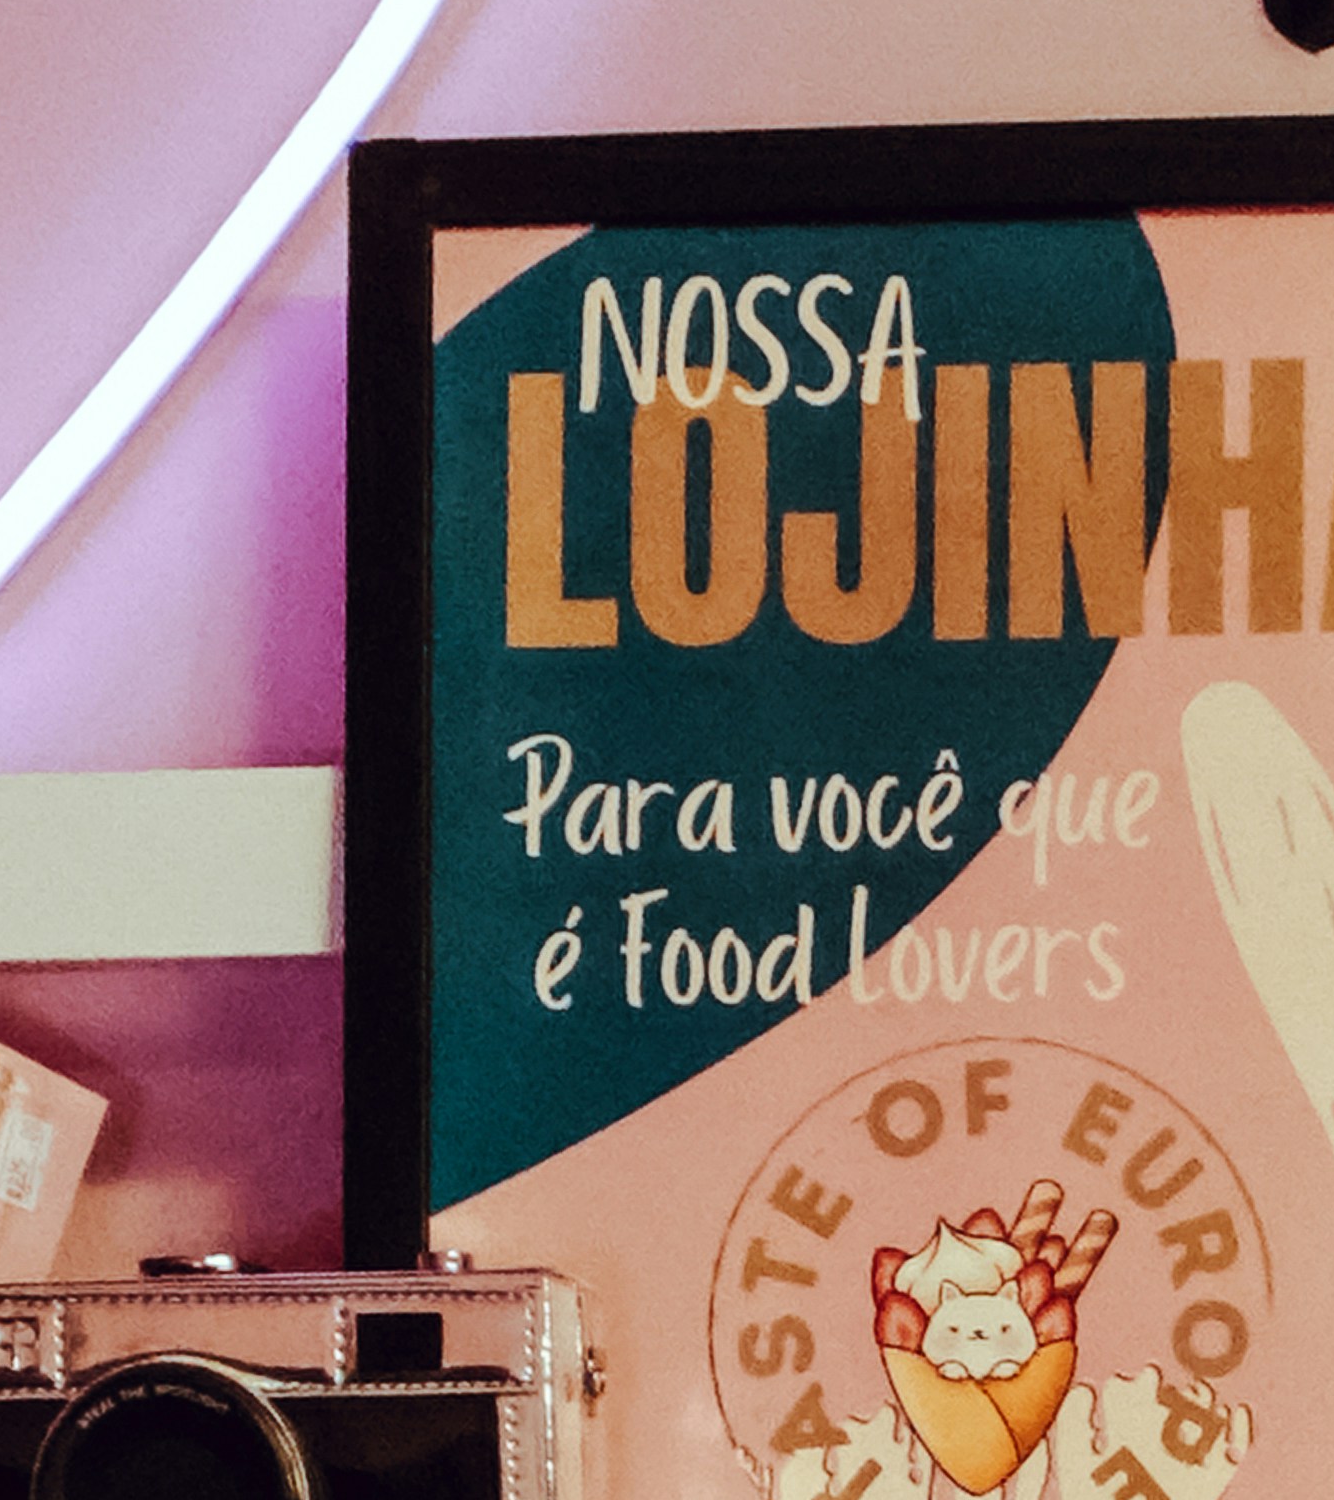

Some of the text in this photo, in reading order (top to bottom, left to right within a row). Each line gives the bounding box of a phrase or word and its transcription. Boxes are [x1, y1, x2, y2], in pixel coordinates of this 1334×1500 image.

[577, 273, 927, 420] NOSSA
[503, 733, 1161, 886] Para você que
[533, 886, 1127, 1012] é Food Lovers
[866, 1059, 1014, 1158] OF
